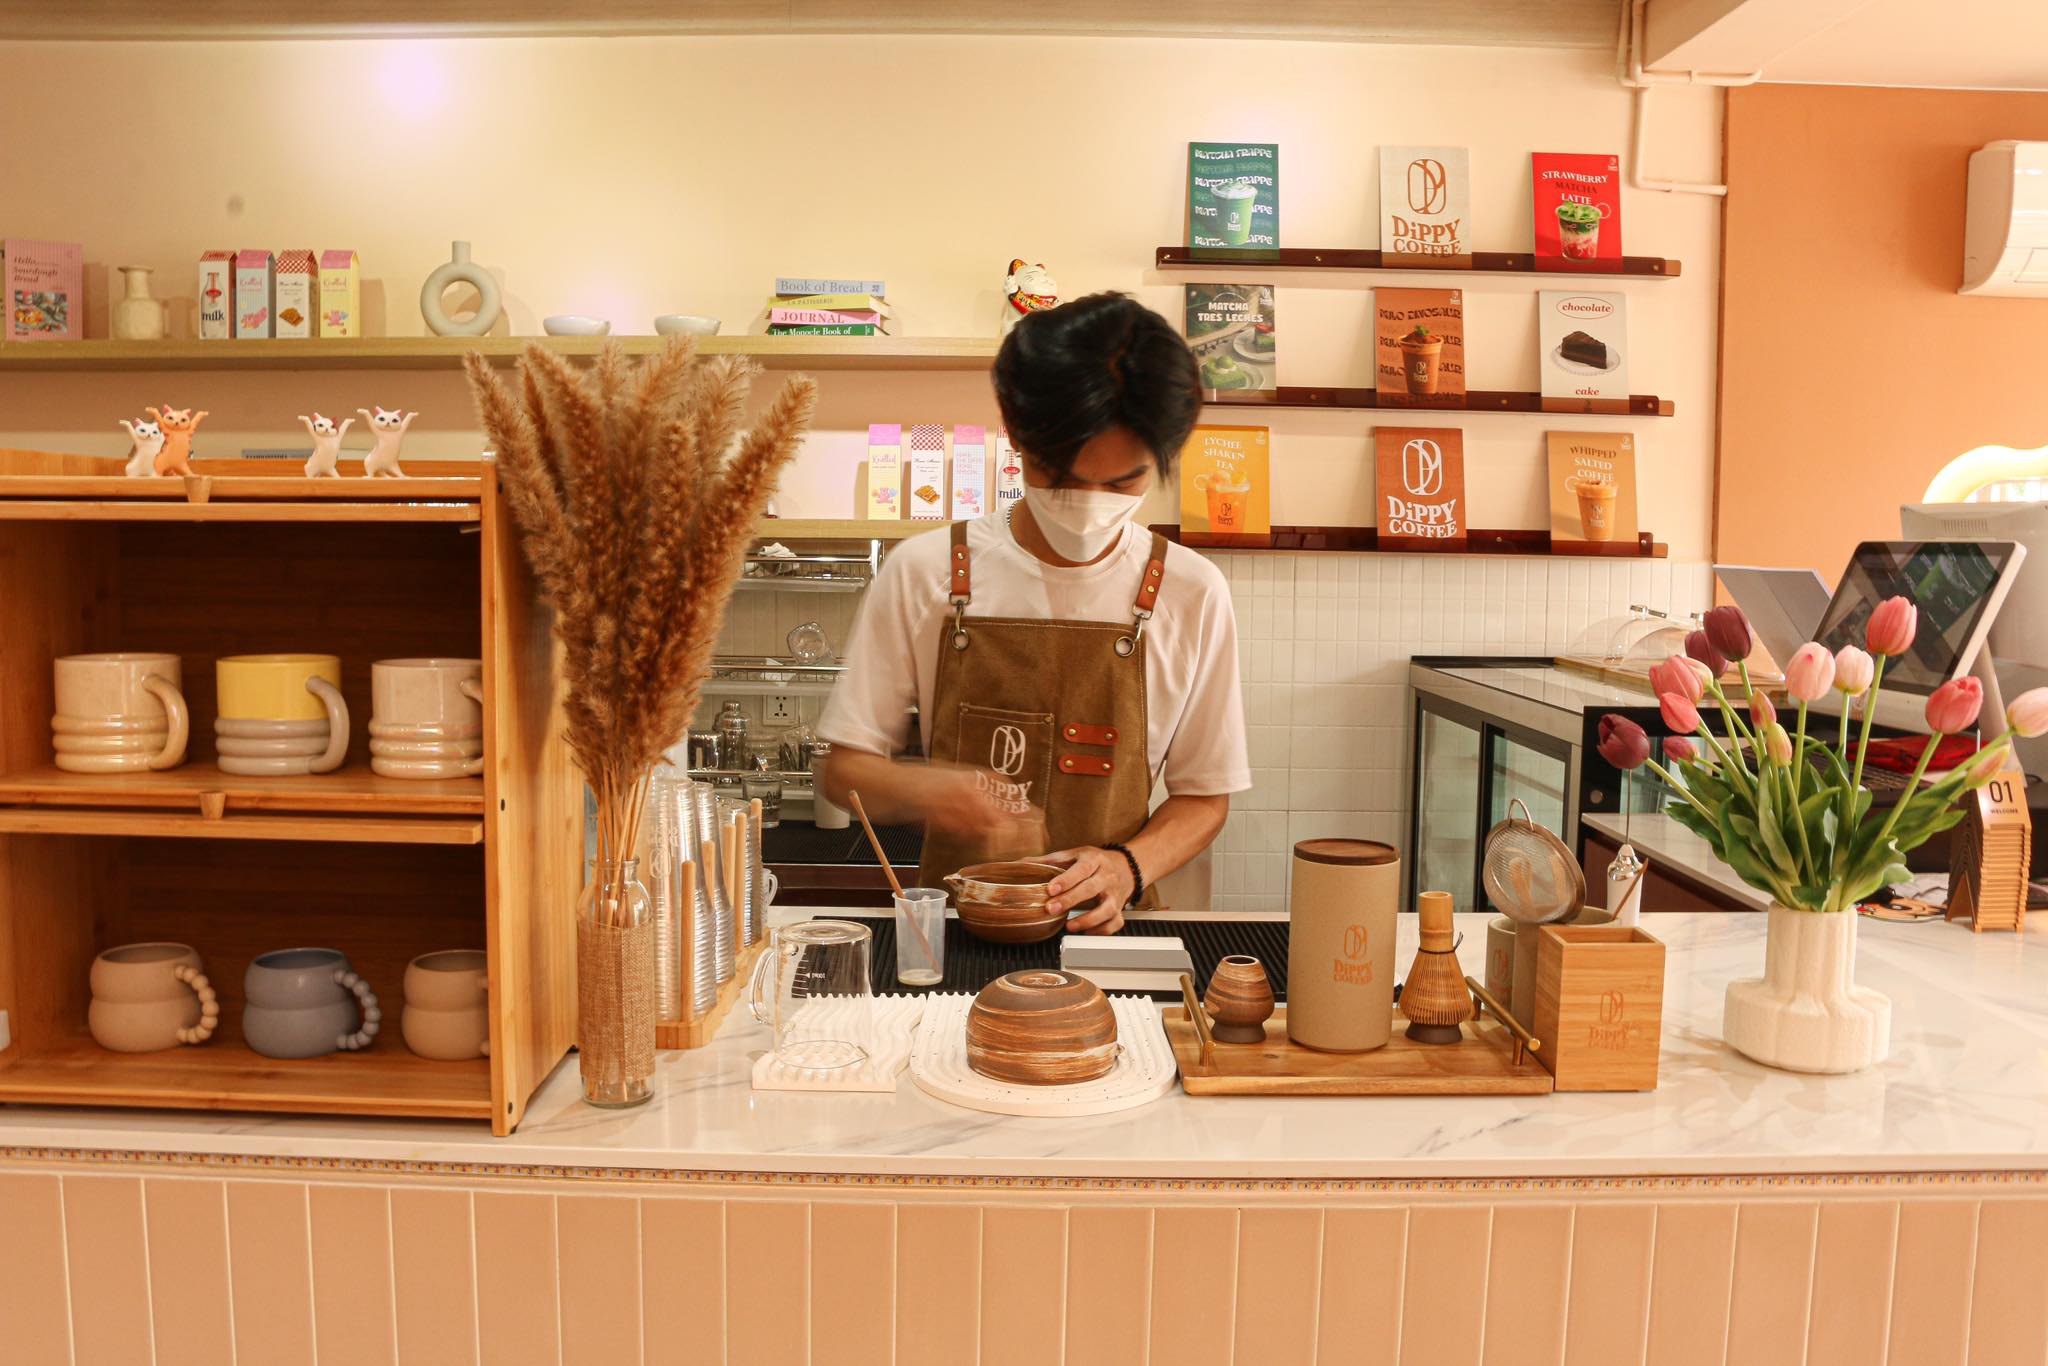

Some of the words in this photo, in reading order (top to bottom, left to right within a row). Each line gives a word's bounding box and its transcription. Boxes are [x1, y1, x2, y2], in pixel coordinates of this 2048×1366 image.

[1236, 148, 1272, 158] FRAPPE
[1542, 170, 1608, 183] STRAWBERRY
[1555, 181, 1597, 194] MATCHA
[1561, 193, 1593, 205] LATTE
[1393, 238, 1461, 258] COFFEE
[781, 280, 812, 292] Book
[814, 281, 827, 292] of
[830, 282, 864, 293] Bread
[1208, 302, 1249, 311] MATCHA
[1562, 303, 1611, 313] chocolate
[201, 310, 225, 321] milk
[781, 311, 845, 324] JOURNAL
[1198, 312, 1223, 322] TRES
[1226, 313, 1264, 323] LECHES
[1407, 307, 1462, 320] DINOSAUR
[772, 328, 788, 336] The
[789, 327, 821, 336] Monocle
[822, 327, 843, 336] Book
[843, 326, 851, 336] of
[1575, 387, 1600, 396] cake
[1204, 437, 1242, 449] LYCHEE
[1203, 448, 1246, 460] SHAKEN
[1570, 446, 1617, 459] WHIPPED
[1216, 460, 1234, 471] TEA
[1574, 457, 1613, 470] SALTED
[1577, 468, 1614, 481] COFFEE
[999, 487, 1023, 499] milk
[1389, 518, 1457, 538] COFFEE
[1989, 779, 2013, 803] 01
